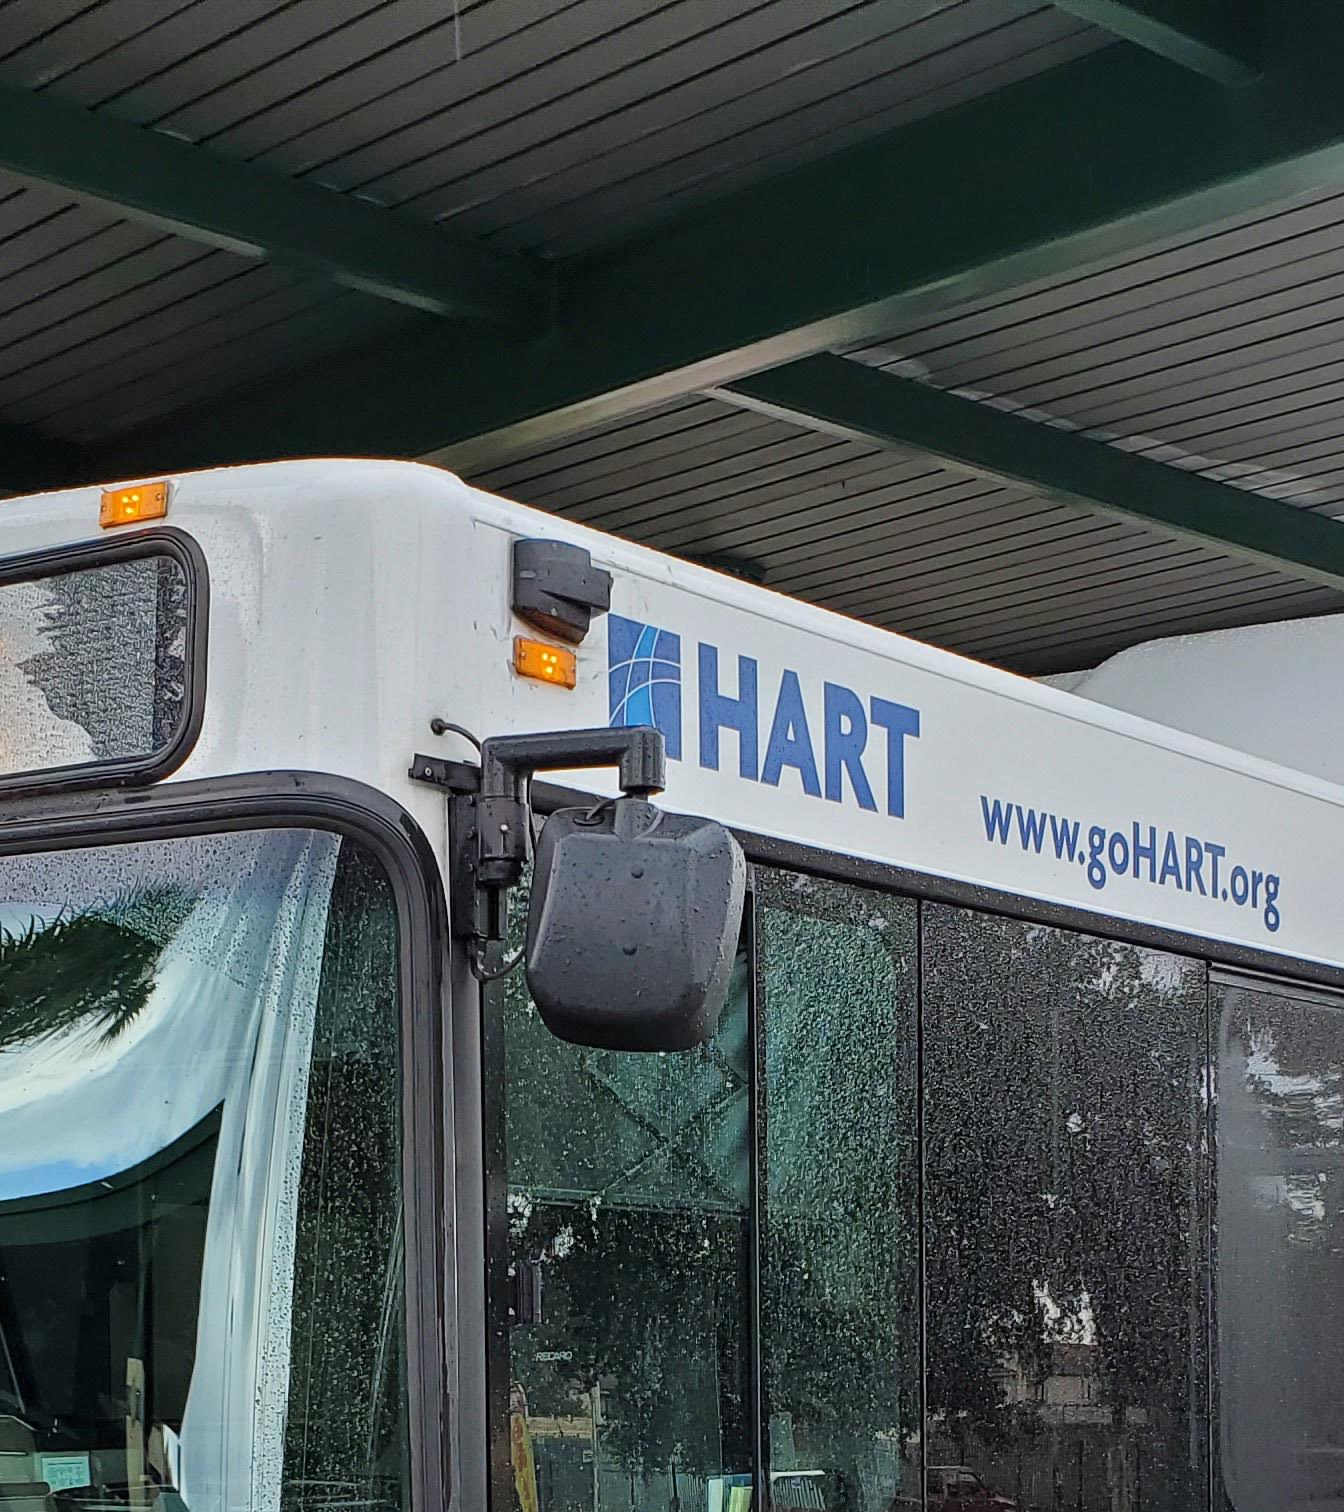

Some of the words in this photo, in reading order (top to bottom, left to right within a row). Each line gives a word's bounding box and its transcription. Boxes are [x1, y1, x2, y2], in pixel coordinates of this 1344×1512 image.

[697, 641, 921, 820] HART
[979, 794, 1281, 932] www.goHART.org
[536, 1351, 573, 1361] RECARO
